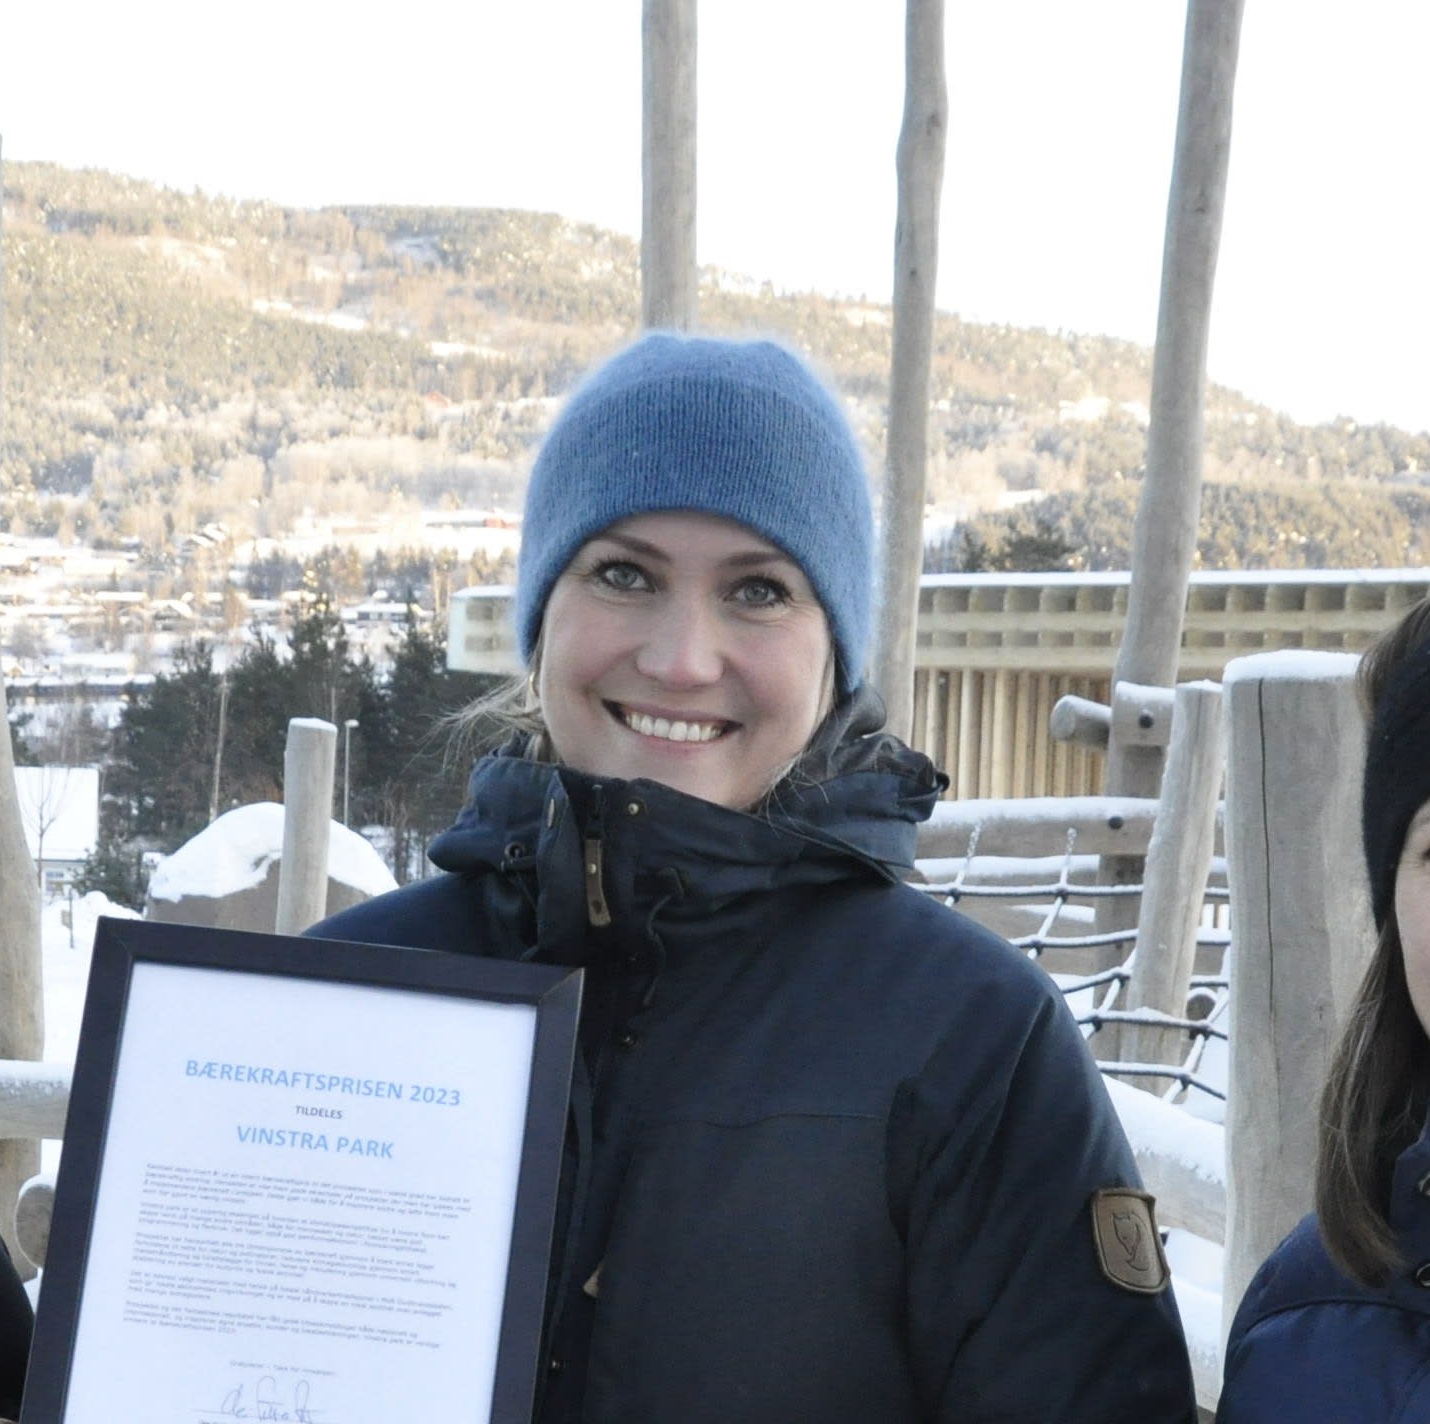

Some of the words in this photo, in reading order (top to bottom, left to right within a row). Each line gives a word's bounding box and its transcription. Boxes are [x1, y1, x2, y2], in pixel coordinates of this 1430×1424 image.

[185, 1059, 403, 1100] BÆREKRAFTSPRISEN
[409, 1084, 461, 1107] 2023
[295, 1105, 343, 1120] TILDELES
[236, 1125, 329, 1152] VINSTRA
[336, 1136, 395, 1160] PARK
